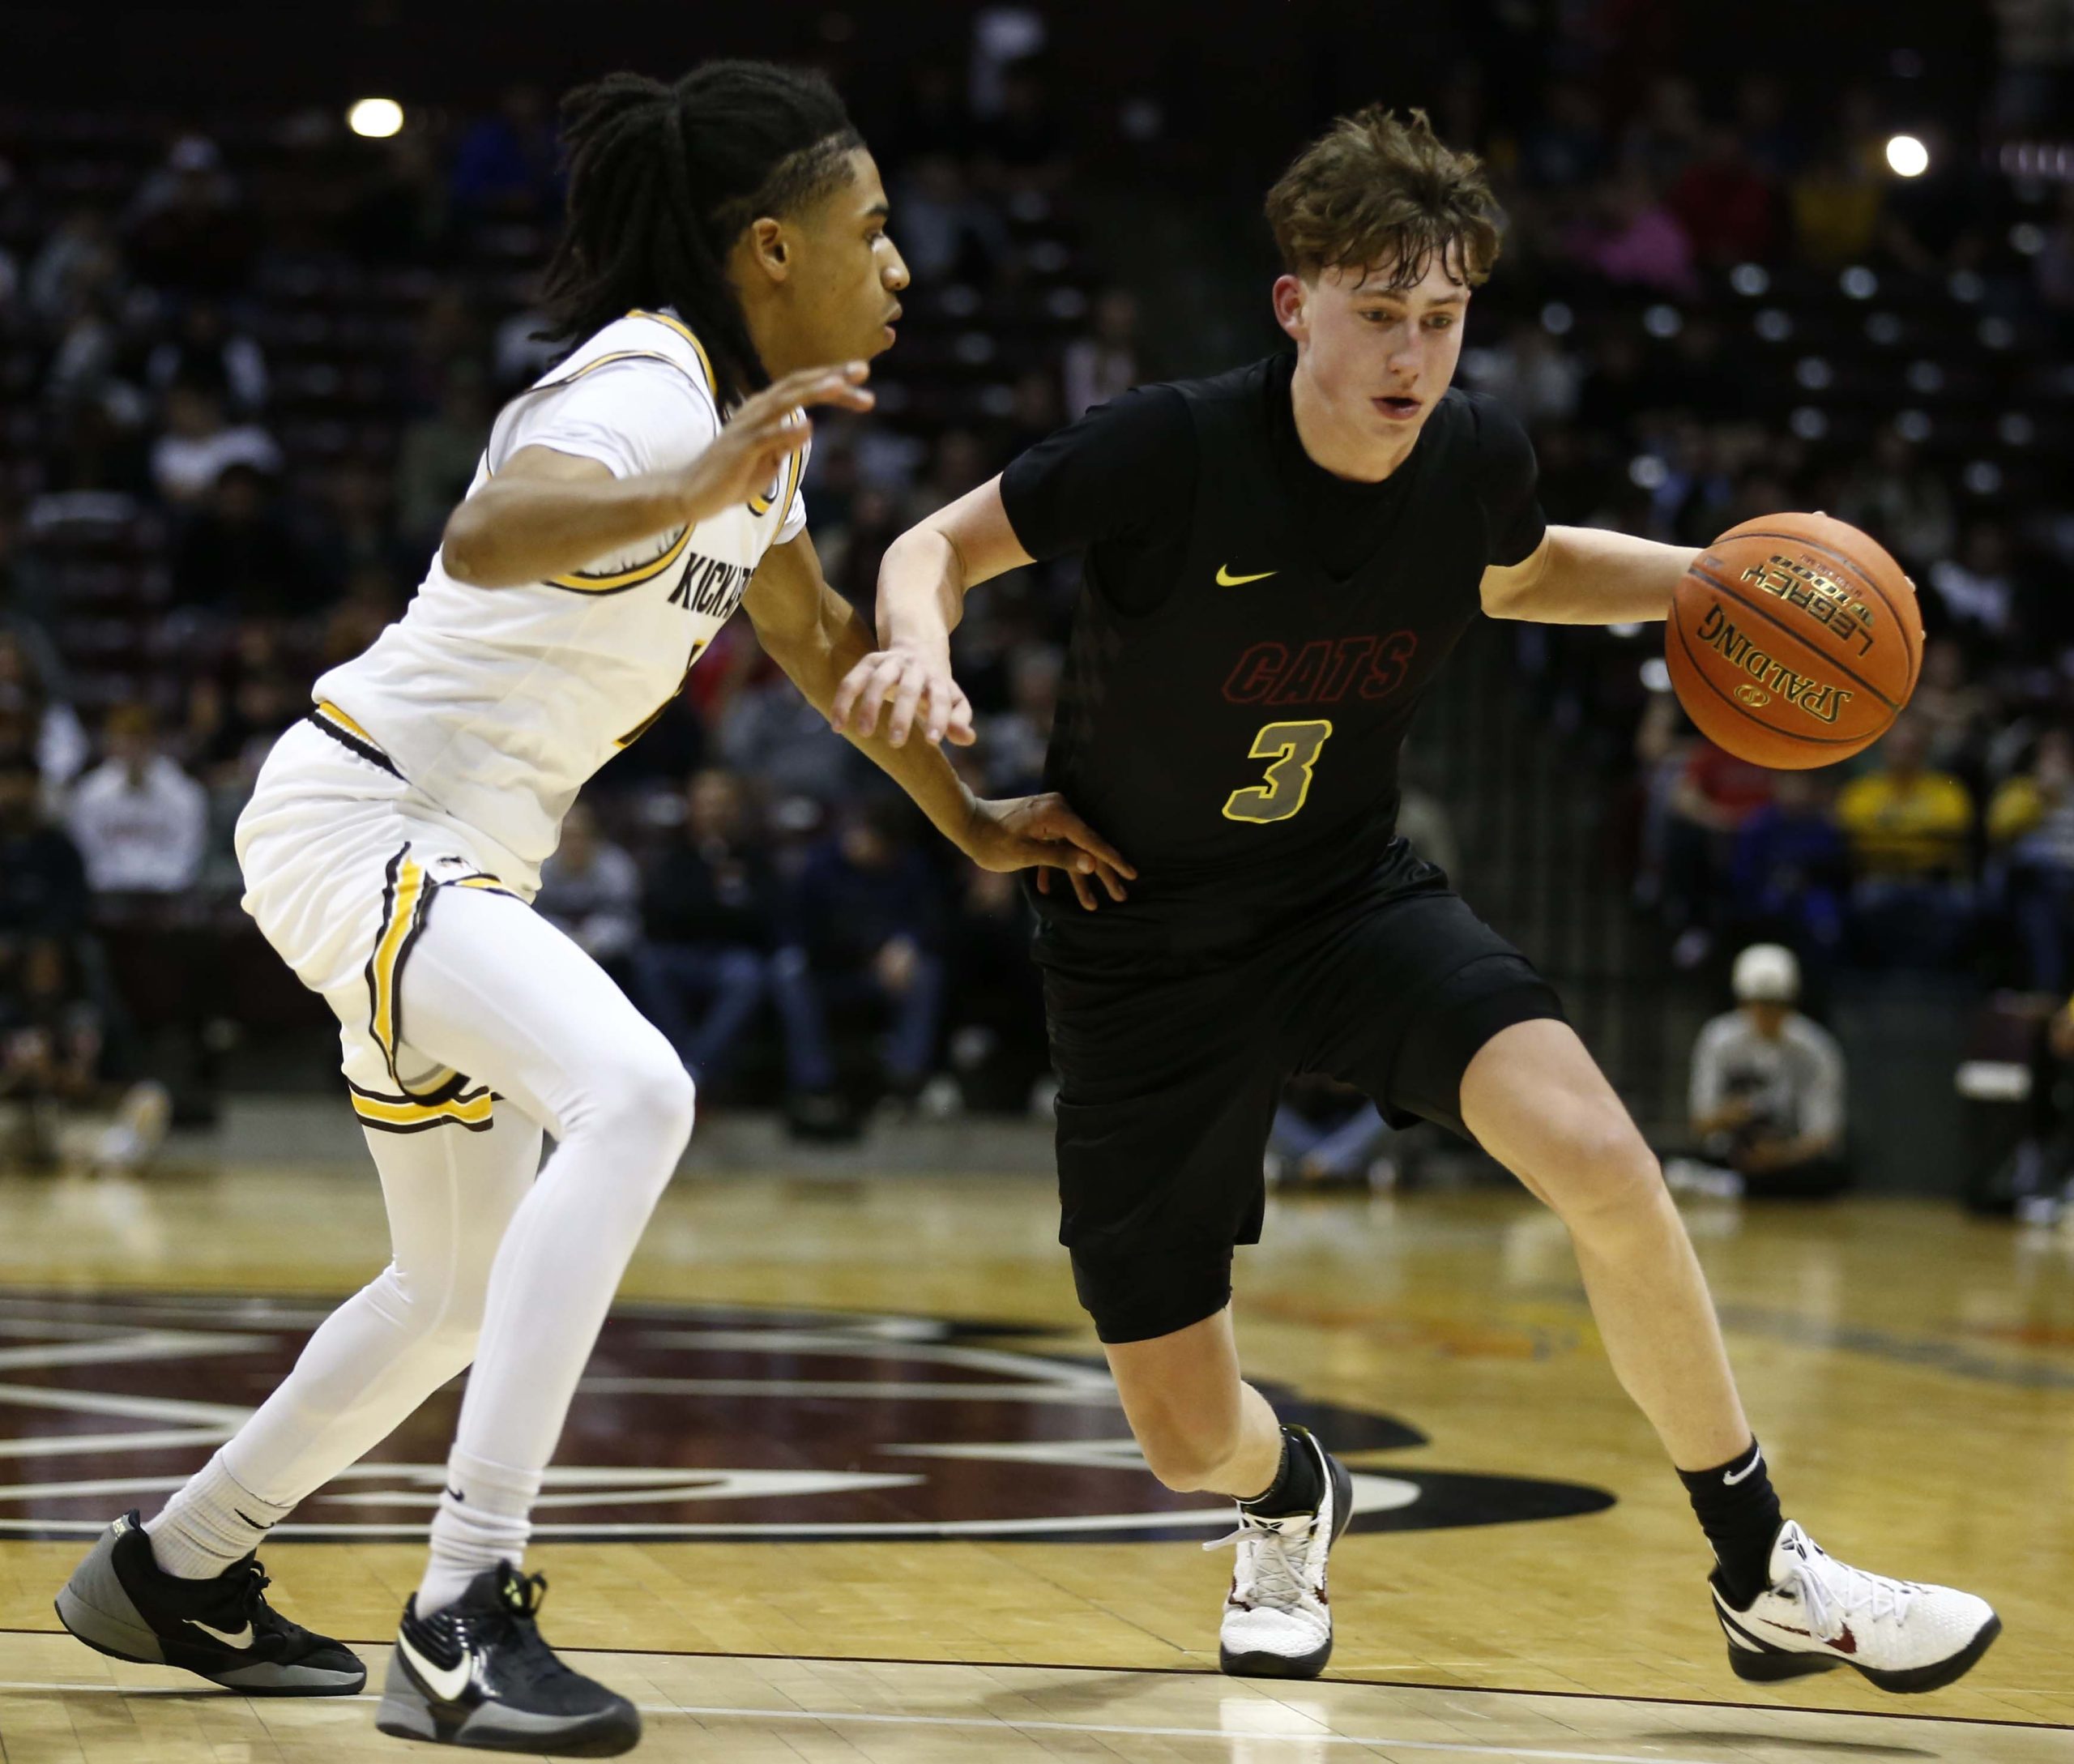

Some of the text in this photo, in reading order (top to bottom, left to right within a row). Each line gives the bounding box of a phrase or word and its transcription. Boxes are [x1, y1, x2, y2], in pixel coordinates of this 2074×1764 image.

[1740, 564, 1874, 658] LEGACY
[1221, 630, 1418, 705] CATS
[1696, 603, 1854, 724] SPALDING
[1222, 719, 1333, 824] 3
